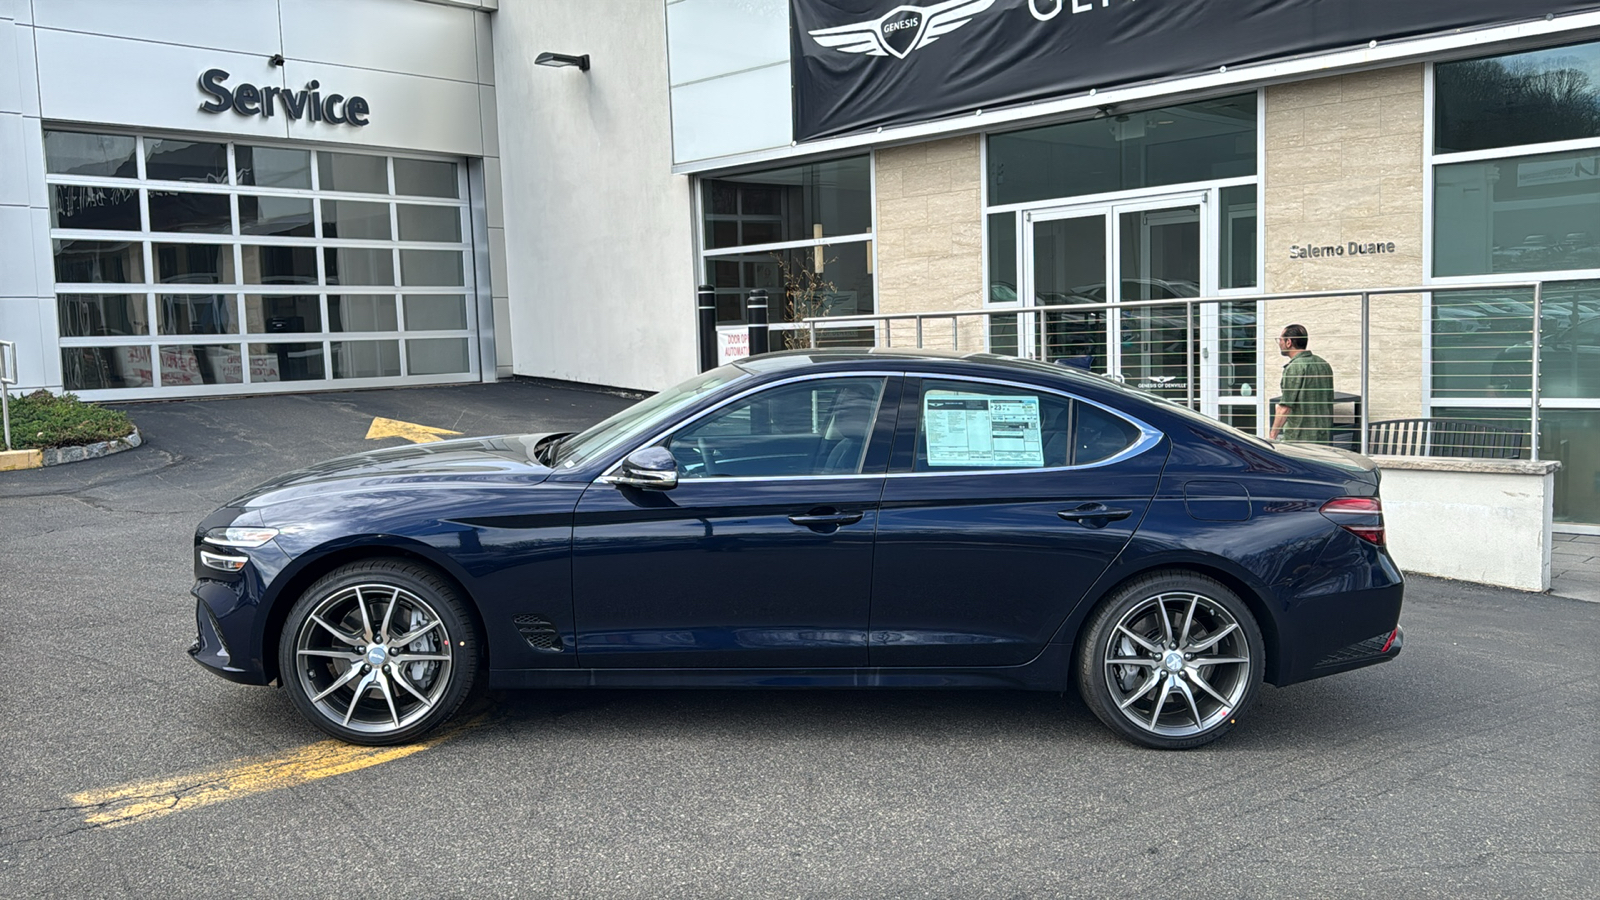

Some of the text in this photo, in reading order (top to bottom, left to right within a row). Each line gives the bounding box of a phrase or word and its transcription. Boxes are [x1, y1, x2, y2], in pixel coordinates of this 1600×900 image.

[883, 17, 919, 33] GENESIS
[199, 68, 370, 127] Service
[1289, 241, 1396, 259] Salerno Duane
[727, 334, 741, 345] DOOR
